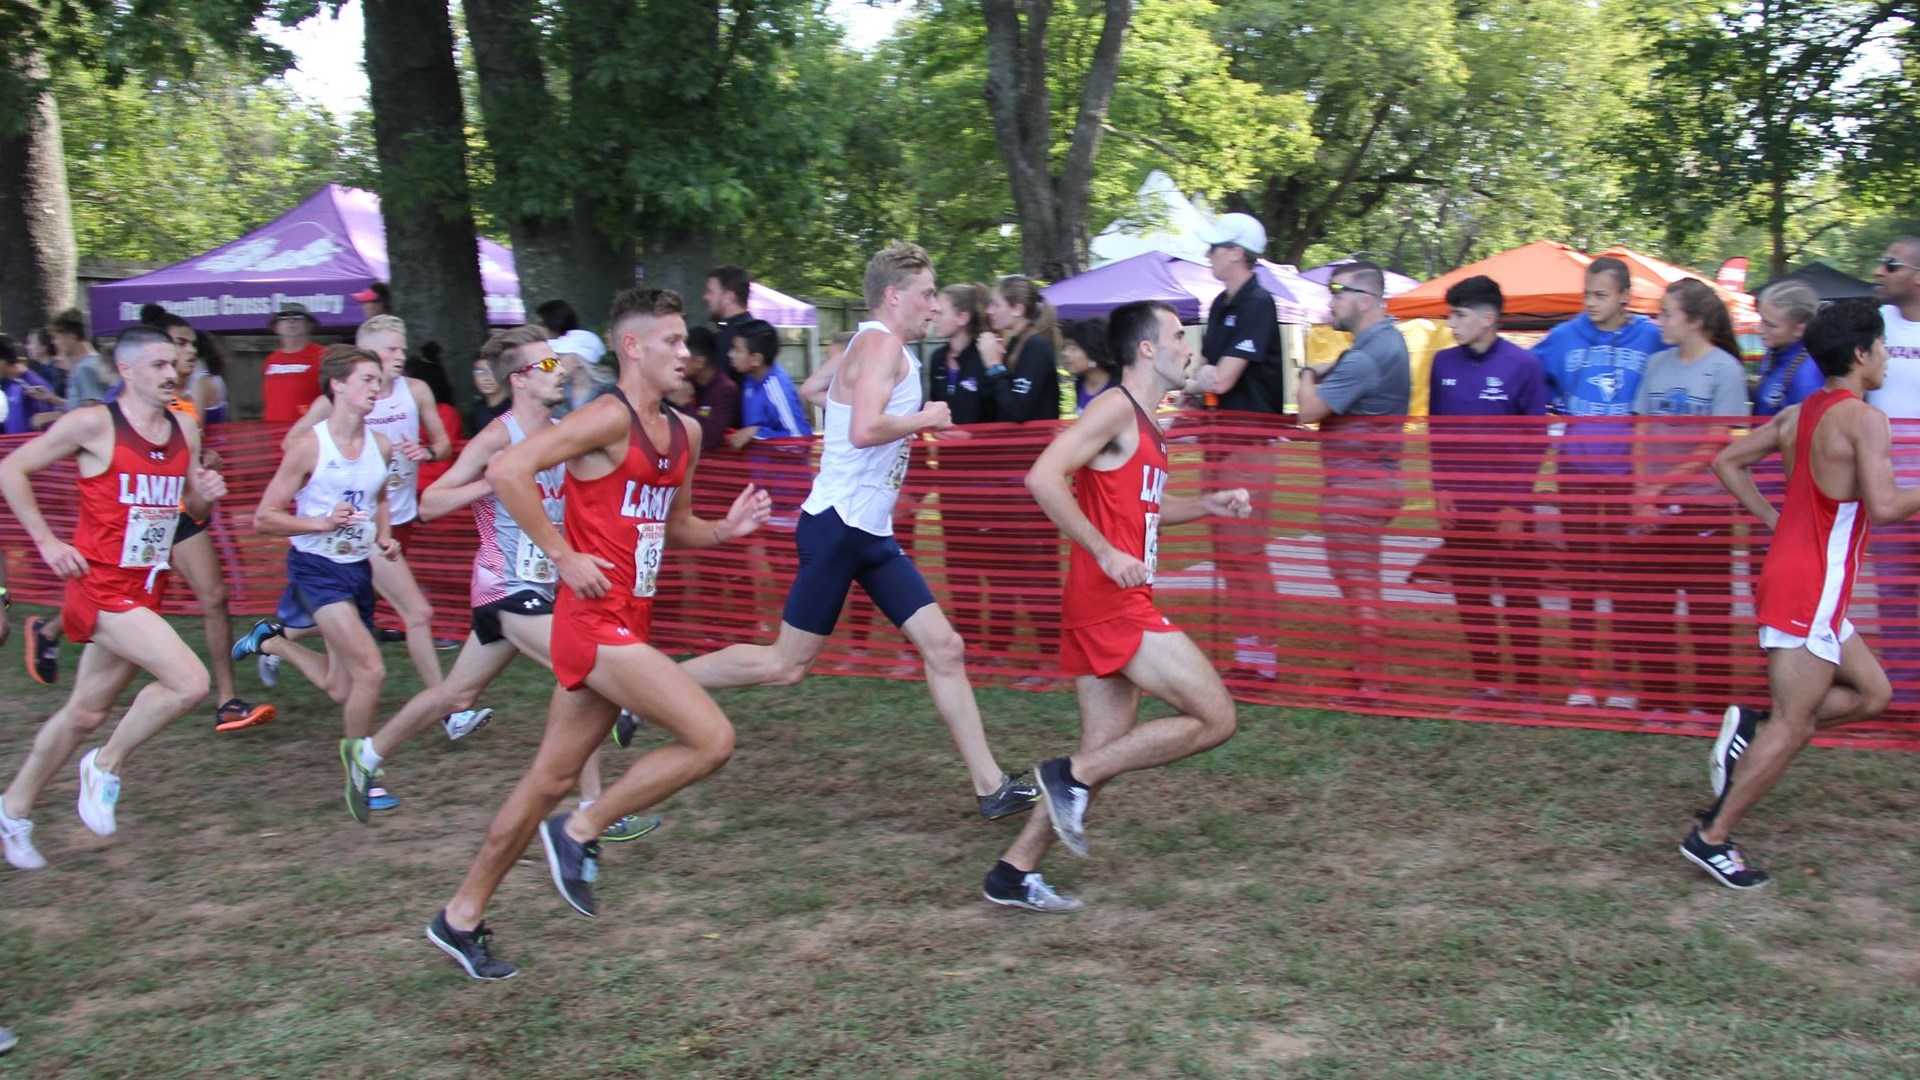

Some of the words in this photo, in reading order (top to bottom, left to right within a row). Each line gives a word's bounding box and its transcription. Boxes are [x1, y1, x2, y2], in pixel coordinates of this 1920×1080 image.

[221, 295, 271, 315] Cross
[141, 527, 166, 544] 439
[336, 526, 364, 541] 794
[643, 548, 662, 568] 43
